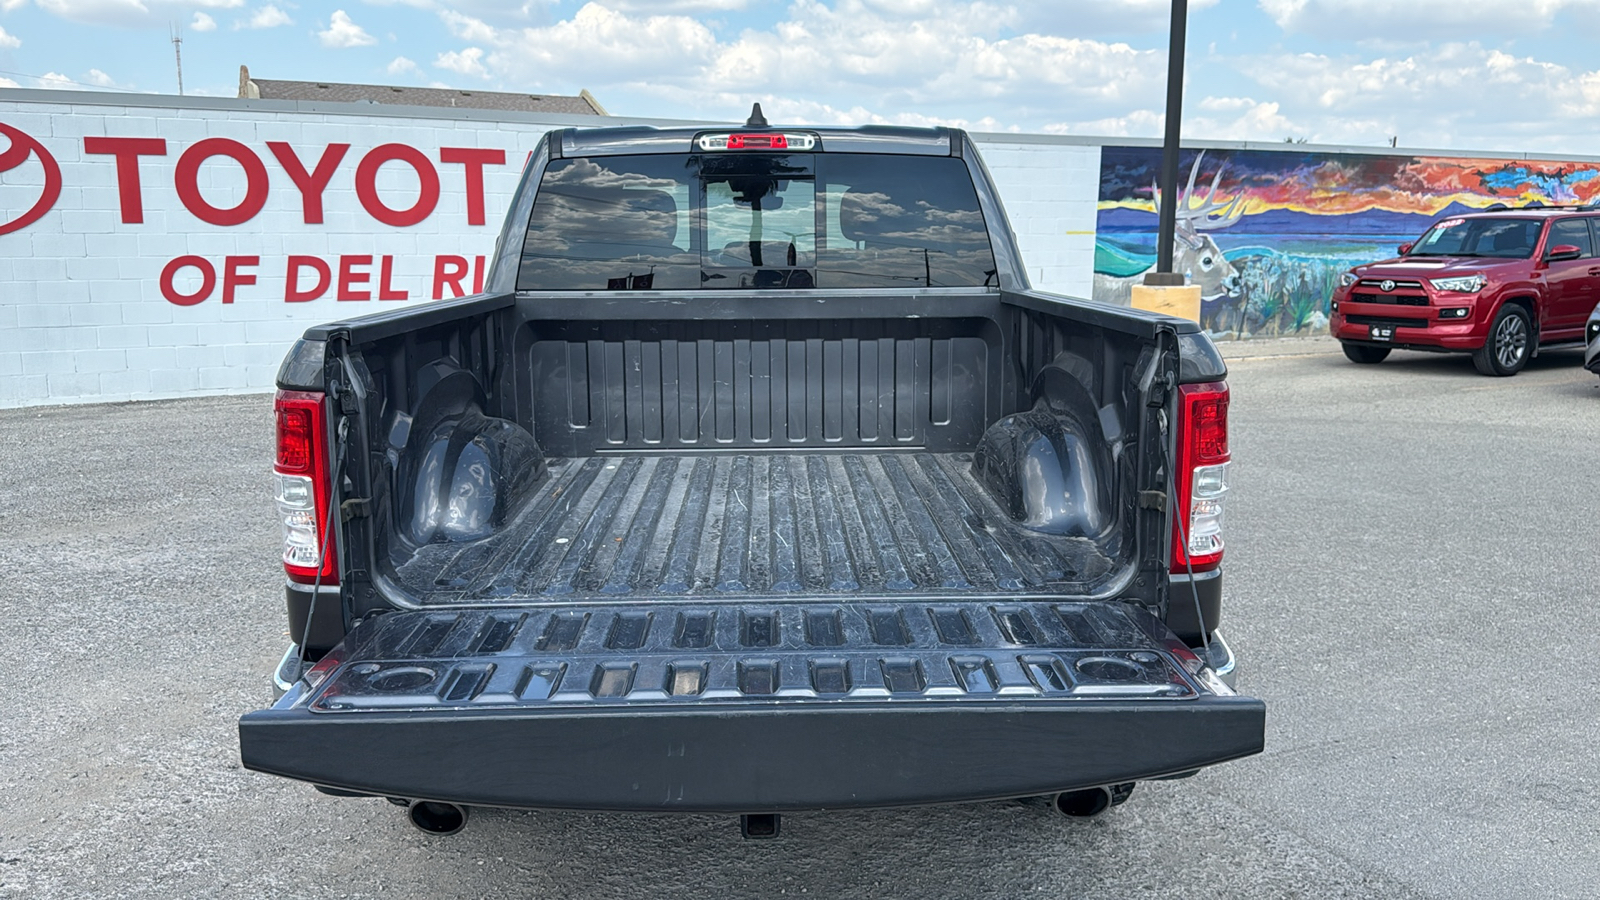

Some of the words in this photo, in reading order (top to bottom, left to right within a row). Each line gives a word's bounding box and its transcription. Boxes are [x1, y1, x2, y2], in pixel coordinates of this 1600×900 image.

[84, 137, 533, 227] TOYOT
[160, 255, 260, 306] OF
[284, 254, 409, 303] DEL
[432, 254, 486, 300] RI
